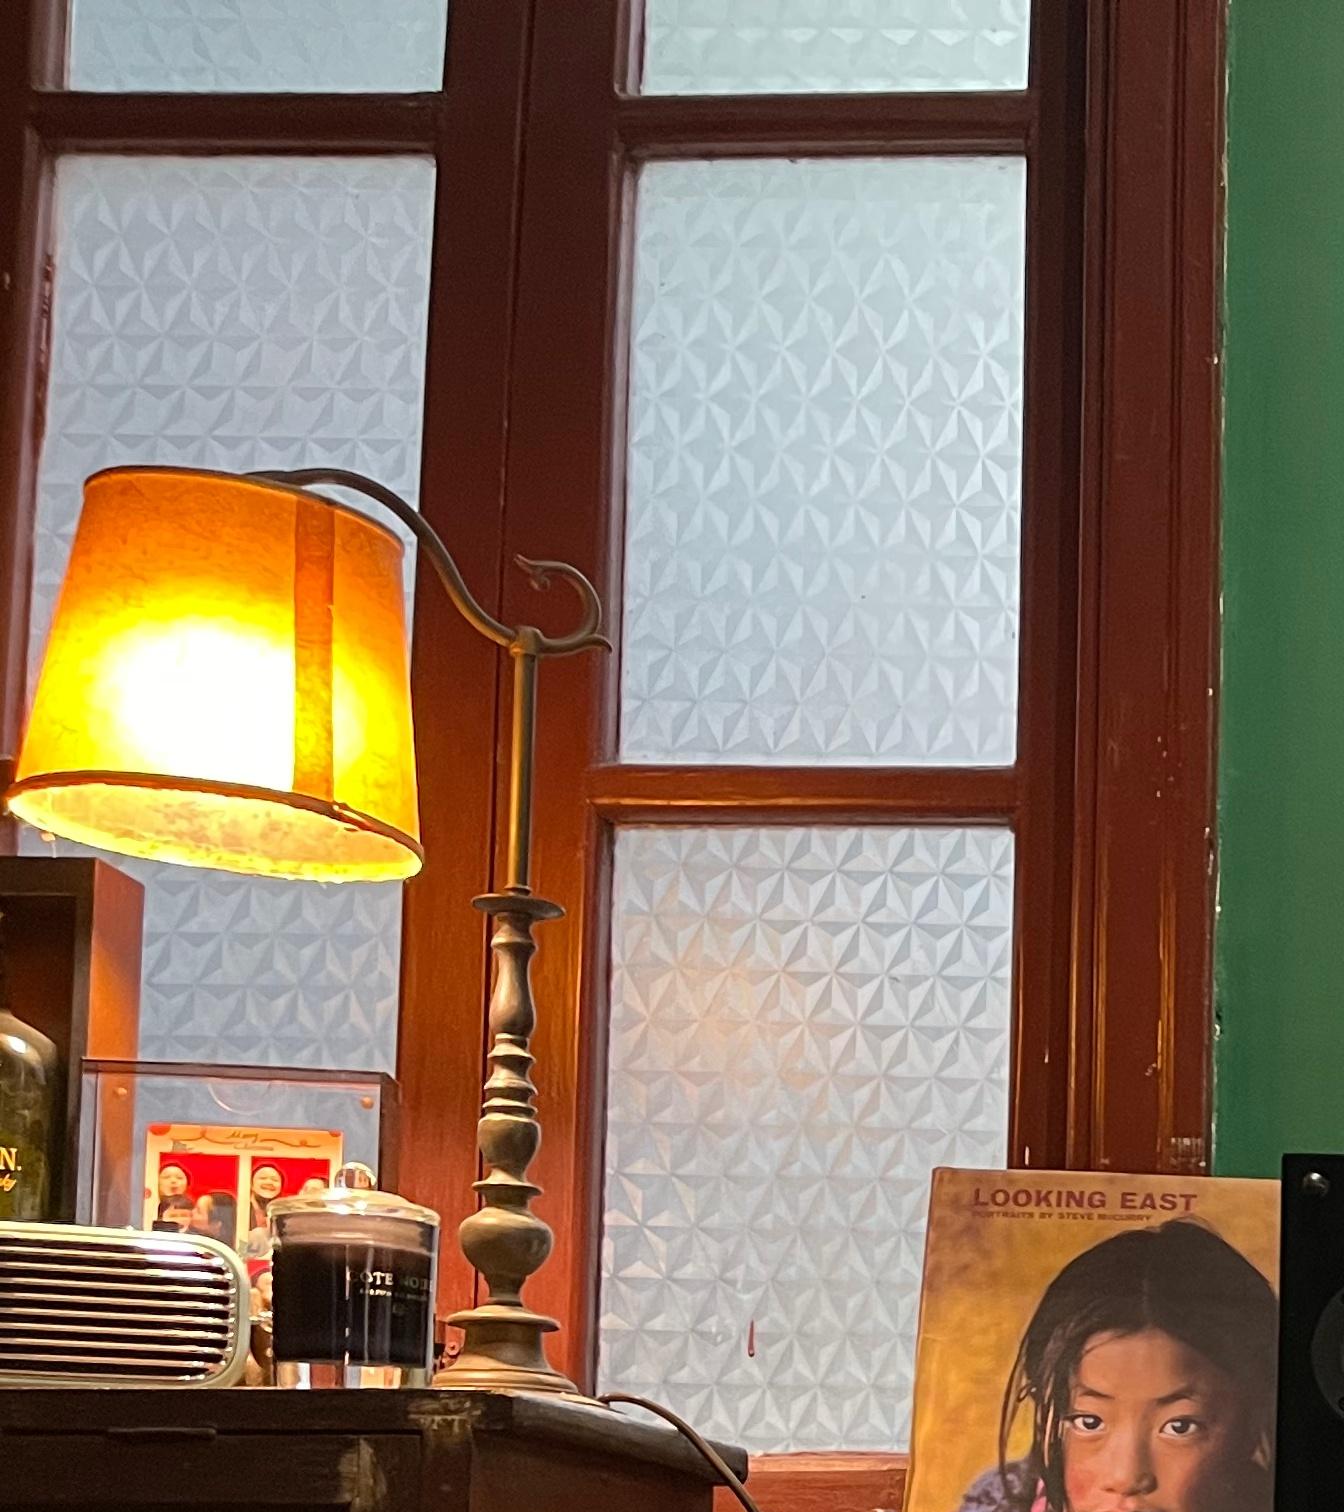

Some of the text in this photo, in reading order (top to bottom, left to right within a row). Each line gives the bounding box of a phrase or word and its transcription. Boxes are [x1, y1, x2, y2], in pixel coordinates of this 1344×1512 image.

[972, 1187, 1198, 1212] LOOKING EAST
[1058, 1212, 1095, 1220] STEVE
